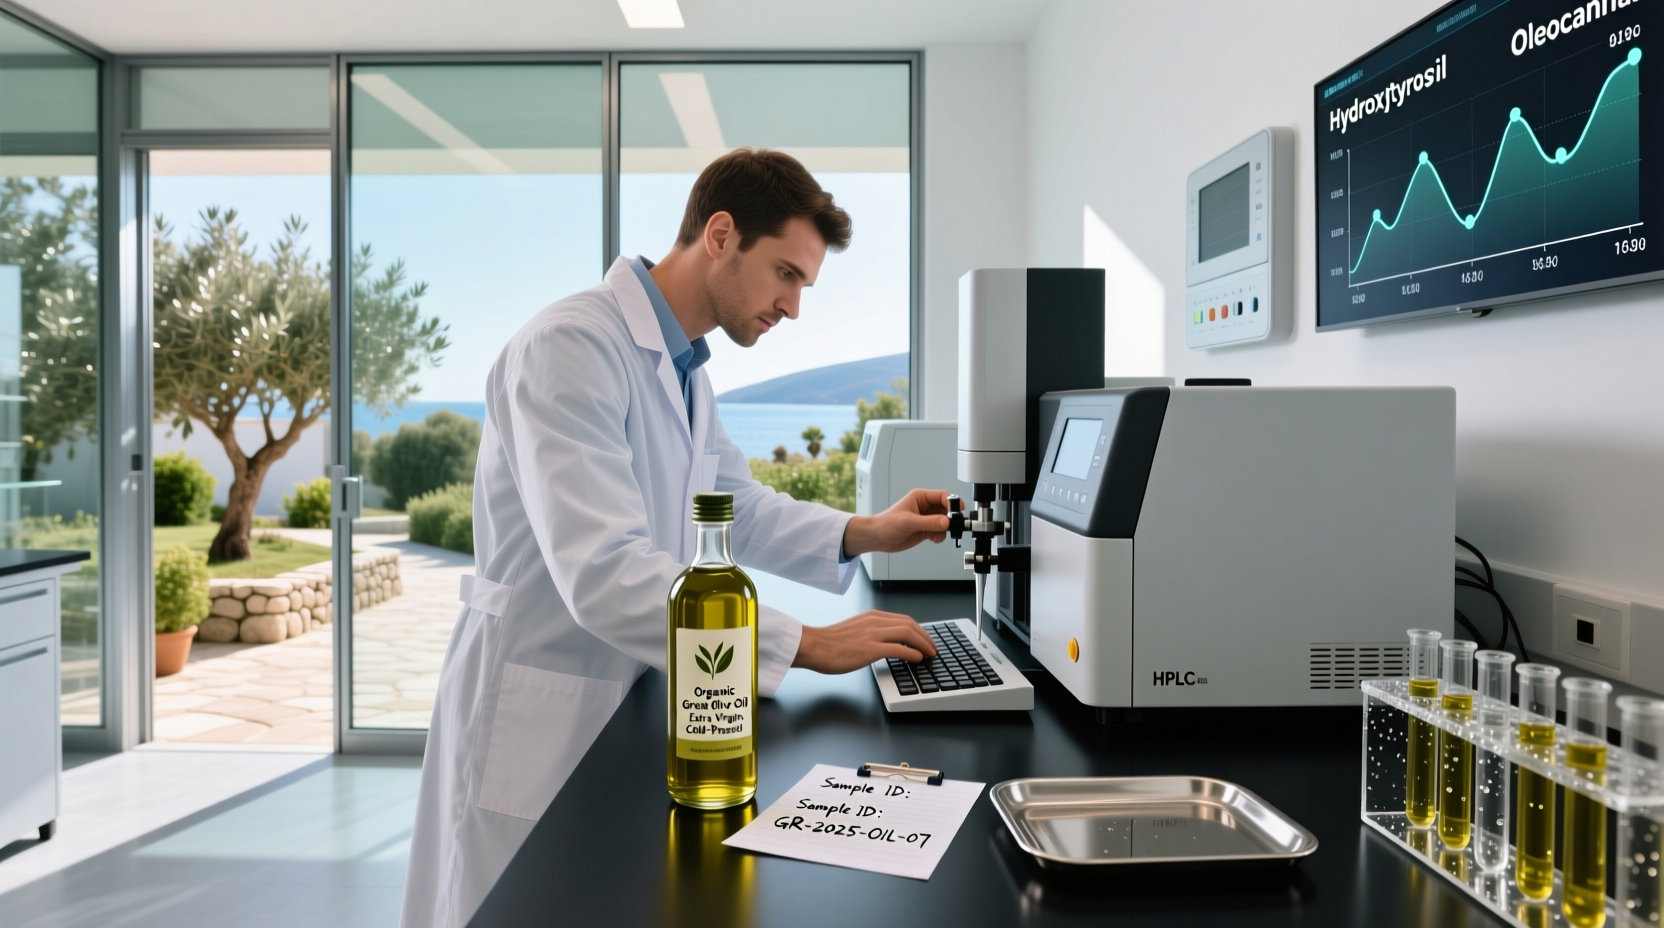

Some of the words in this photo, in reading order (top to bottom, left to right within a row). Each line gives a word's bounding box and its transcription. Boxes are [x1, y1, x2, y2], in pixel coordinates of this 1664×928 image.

[1153, 671, 1196, 686] HPLC
[694, 685, 735, 700] Organic
[734, 697, 748, 709] Oil
[820, 777, 874, 796] Sample
[885, 785, 911, 798] ID:
[796, 799, 851, 817] Sample
[855, 805, 883, 819] ID:
[774, 816, 931, 848] GR-2025-OIL-07
